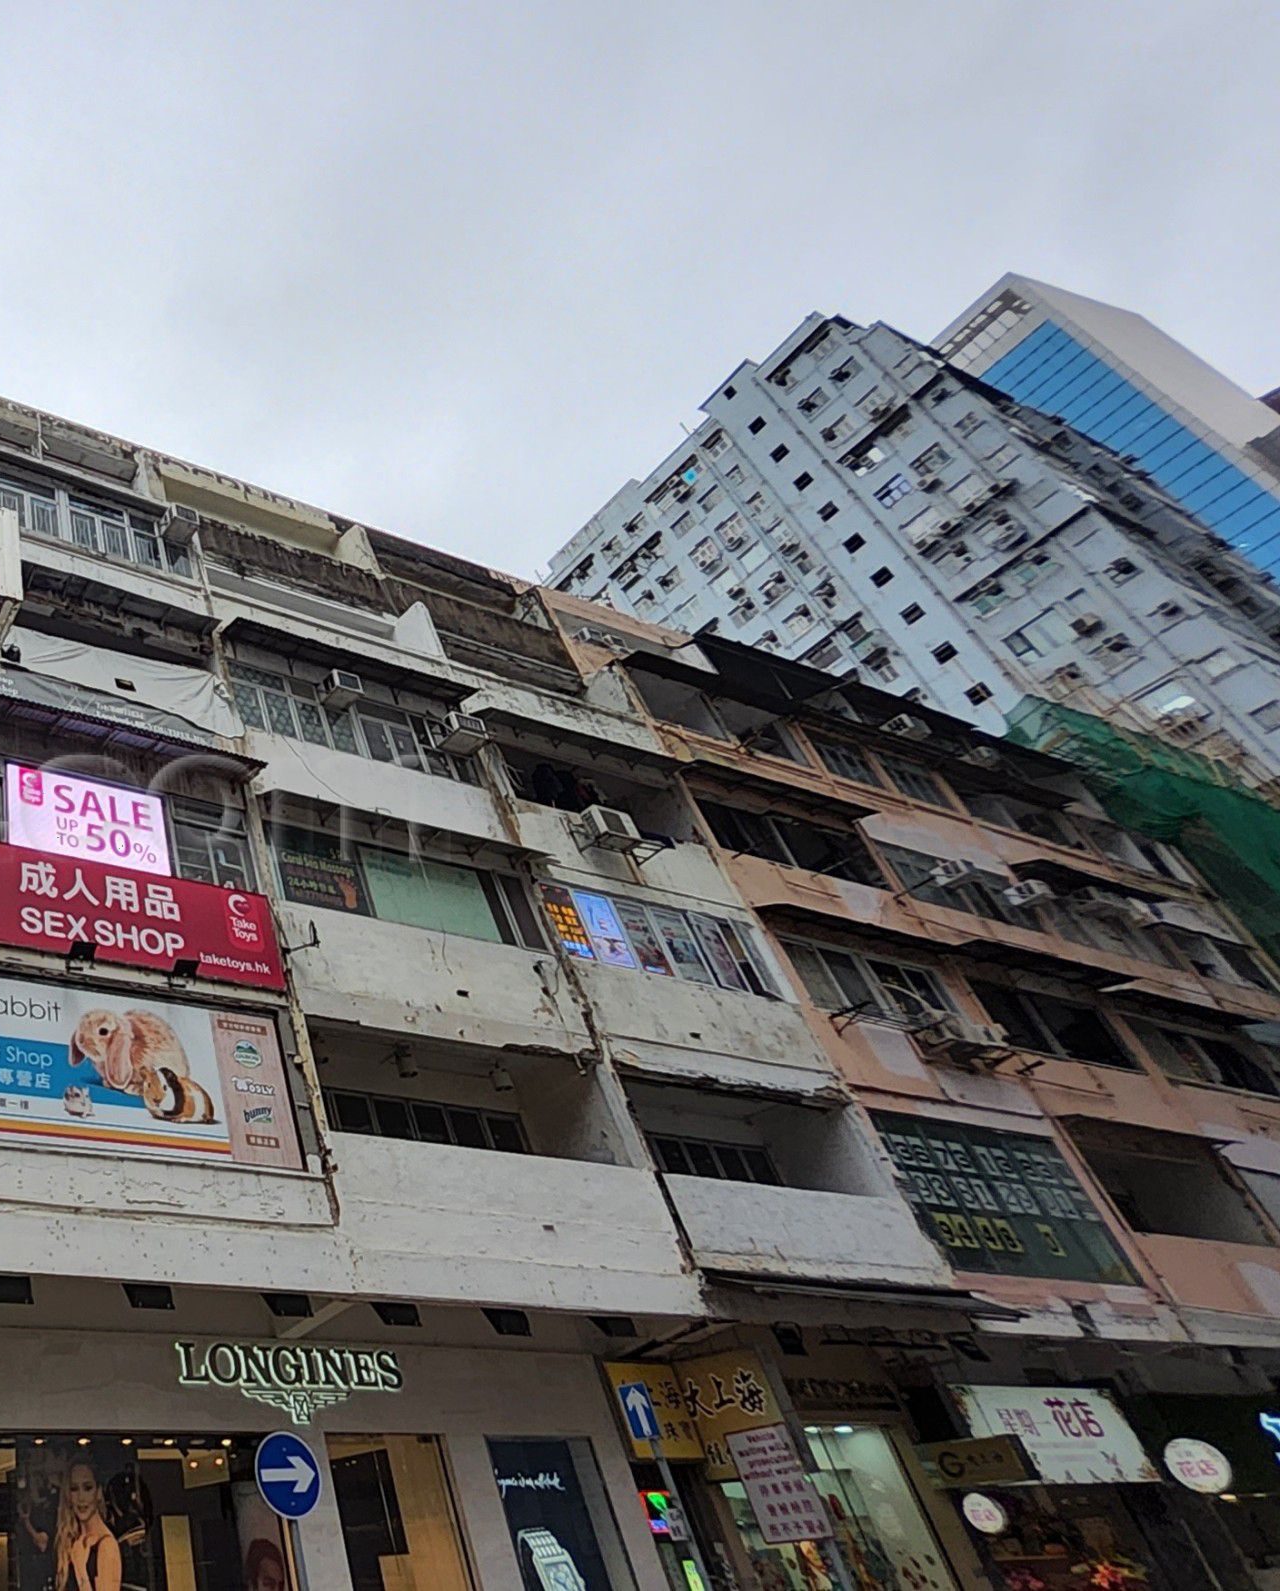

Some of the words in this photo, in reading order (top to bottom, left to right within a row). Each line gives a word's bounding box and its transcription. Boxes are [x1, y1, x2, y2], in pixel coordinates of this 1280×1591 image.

[53, 784, 153, 832] SALE
[56, 816, 78, 832] UP
[57, 831, 79, 848] TO
[86, 823, 157, 864] 50%
[19, 861, 182, 923] 成人用品
[20, 907, 90, 943] SEX
[93, 921, 185, 957] SHOP
[230, 916, 257, 932] Take
[232, 927, 259, 943] Toys
[199, 951, 272, 975] taketoys.hk
[5, 1045, 53, 1069] Shop
[175, 1342, 403, 1390] LONGINES
[683, 1370, 767, 1420] 大上海
[1043, 1397, 1105, 1438] 花店
